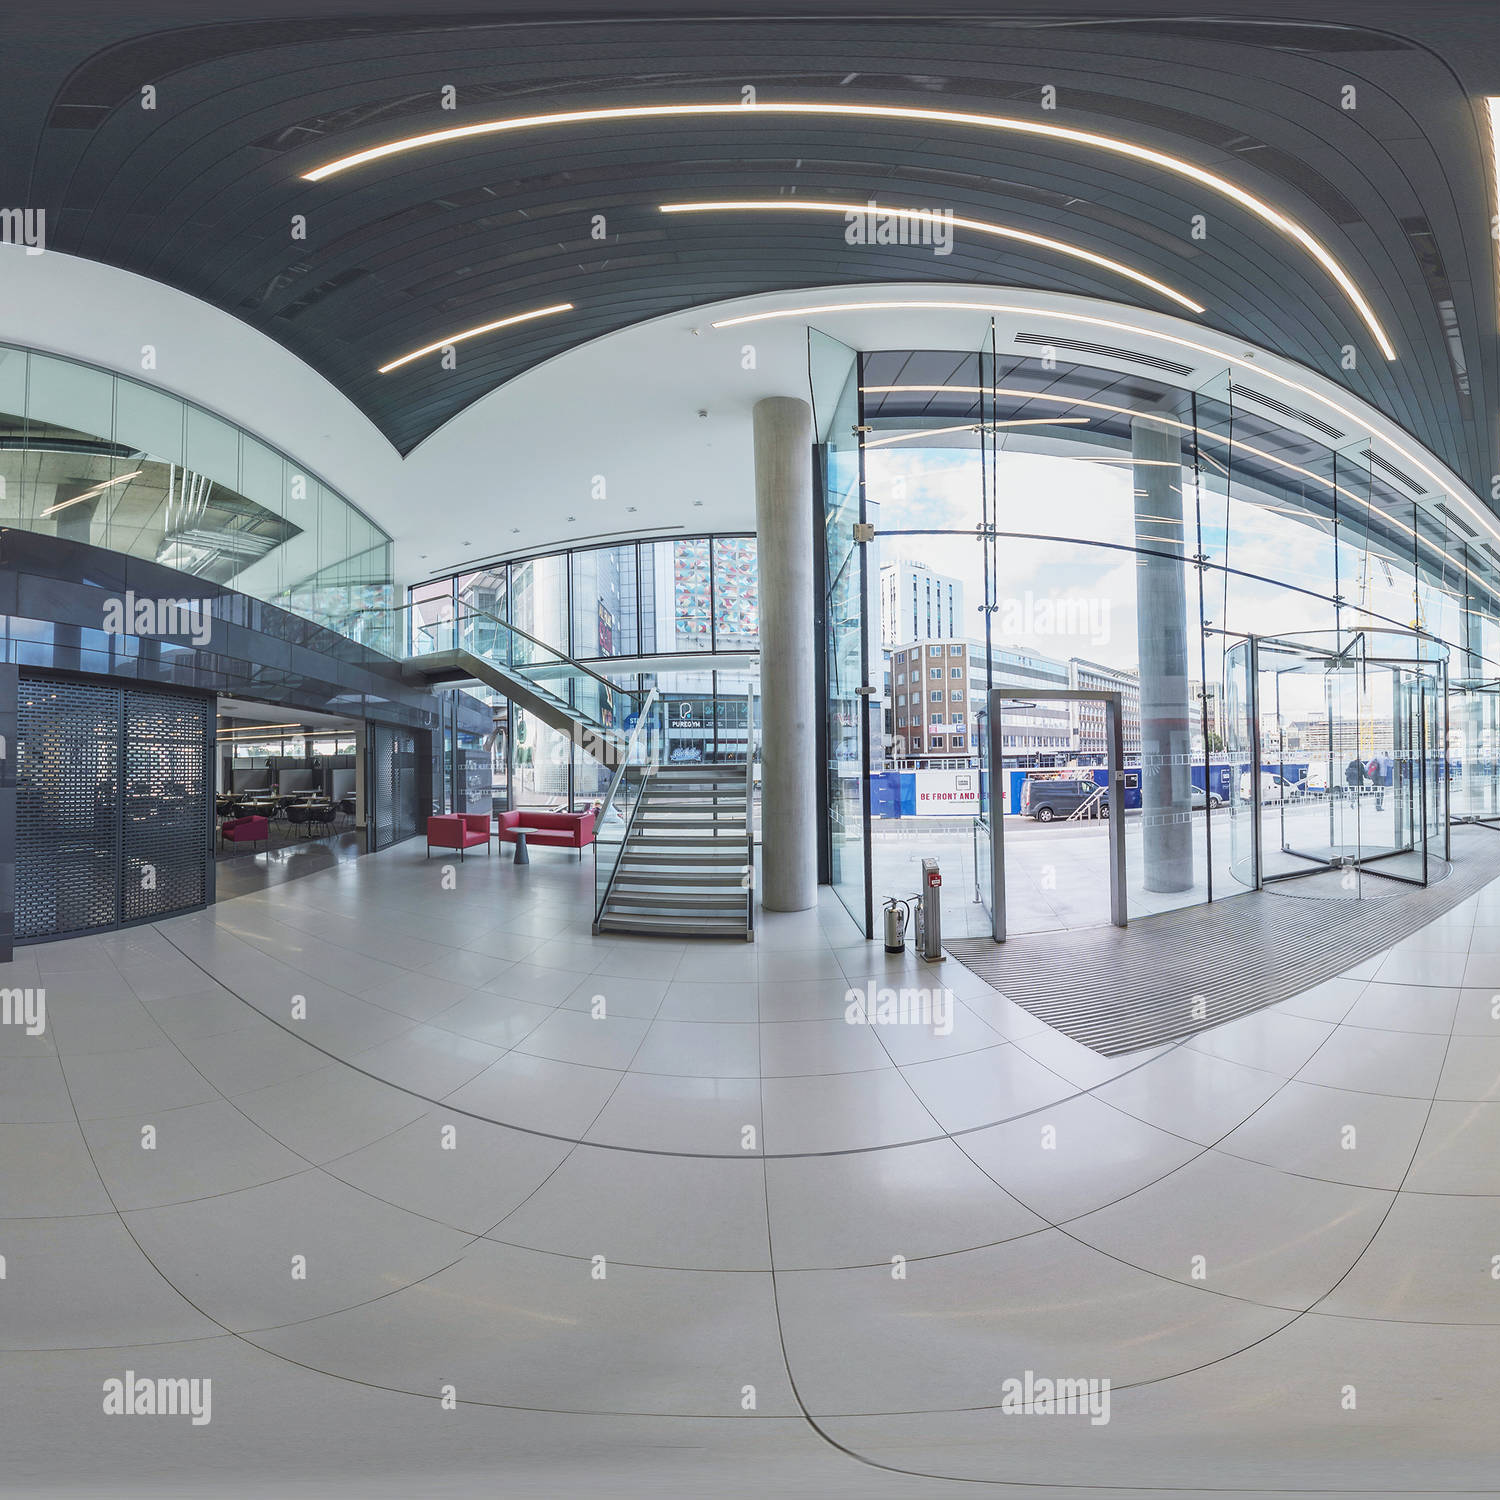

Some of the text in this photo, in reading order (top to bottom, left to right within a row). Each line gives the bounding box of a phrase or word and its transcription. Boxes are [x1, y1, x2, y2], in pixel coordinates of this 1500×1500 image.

[920, 792, 930, 801] BE
[932, 792, 957, 801] FRONT
[959, 792, 975, 800] AND
